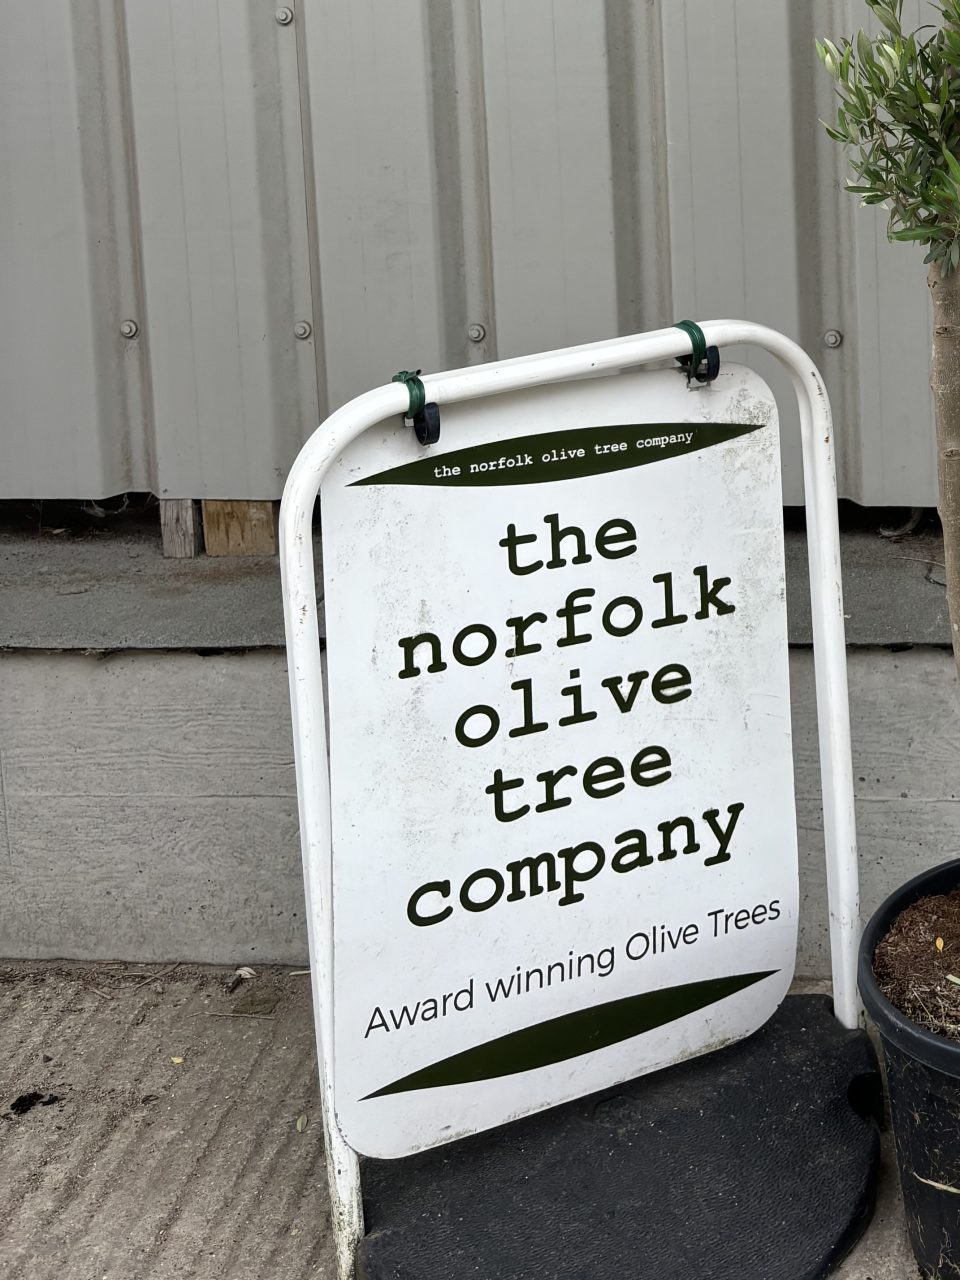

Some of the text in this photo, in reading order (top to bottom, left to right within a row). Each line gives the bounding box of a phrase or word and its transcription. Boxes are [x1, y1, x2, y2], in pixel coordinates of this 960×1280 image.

[433, 431, 694, 478] the norfolk olive tree company
[498, 513, 638, 576] the
[398, 565, 736, 680] norfolk
[453, 662, 692, 748] olive
[485, 745, 672, 823] tree
[406, 802, 745, 928] company
[363, 898, 781, 1039] Award winning Olive Trees
